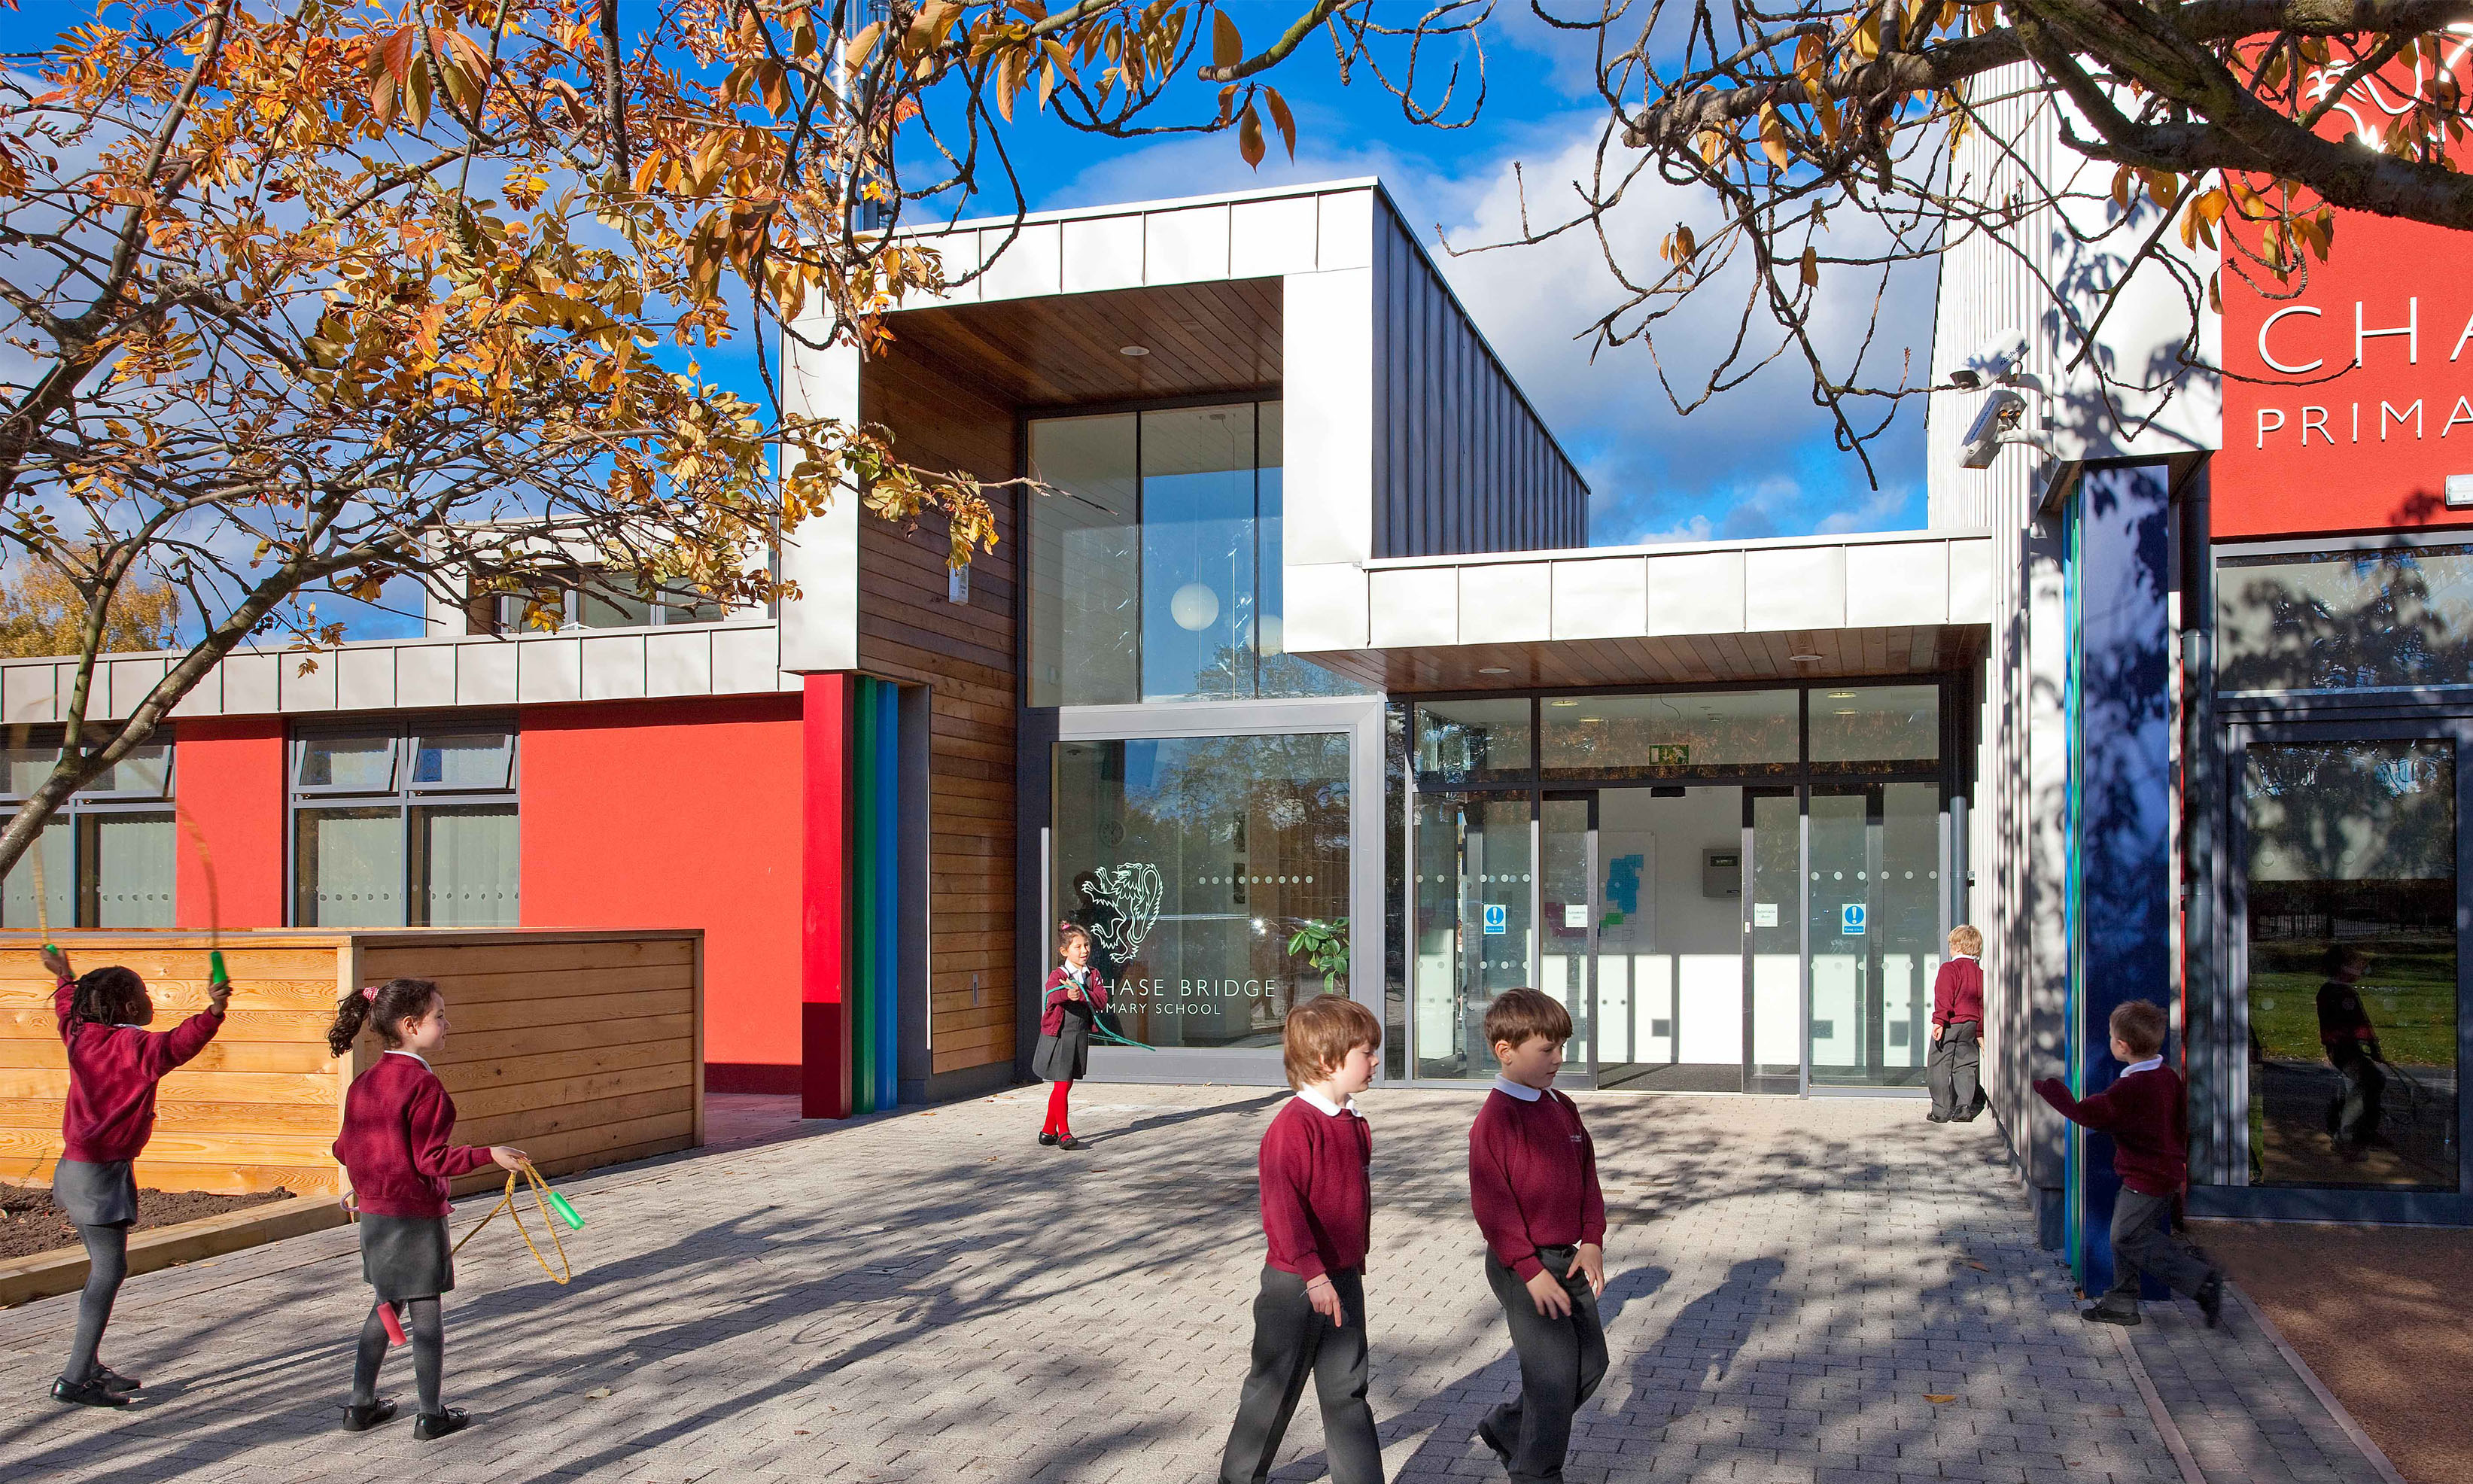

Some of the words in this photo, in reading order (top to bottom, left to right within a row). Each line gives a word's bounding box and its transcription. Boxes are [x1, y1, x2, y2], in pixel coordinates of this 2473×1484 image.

[1101, 978, 1164, 996] HASE
[1180, 979, 1276, 997] BRIDGE
[1155, 1003, 1221, 1015] SCHOOL
